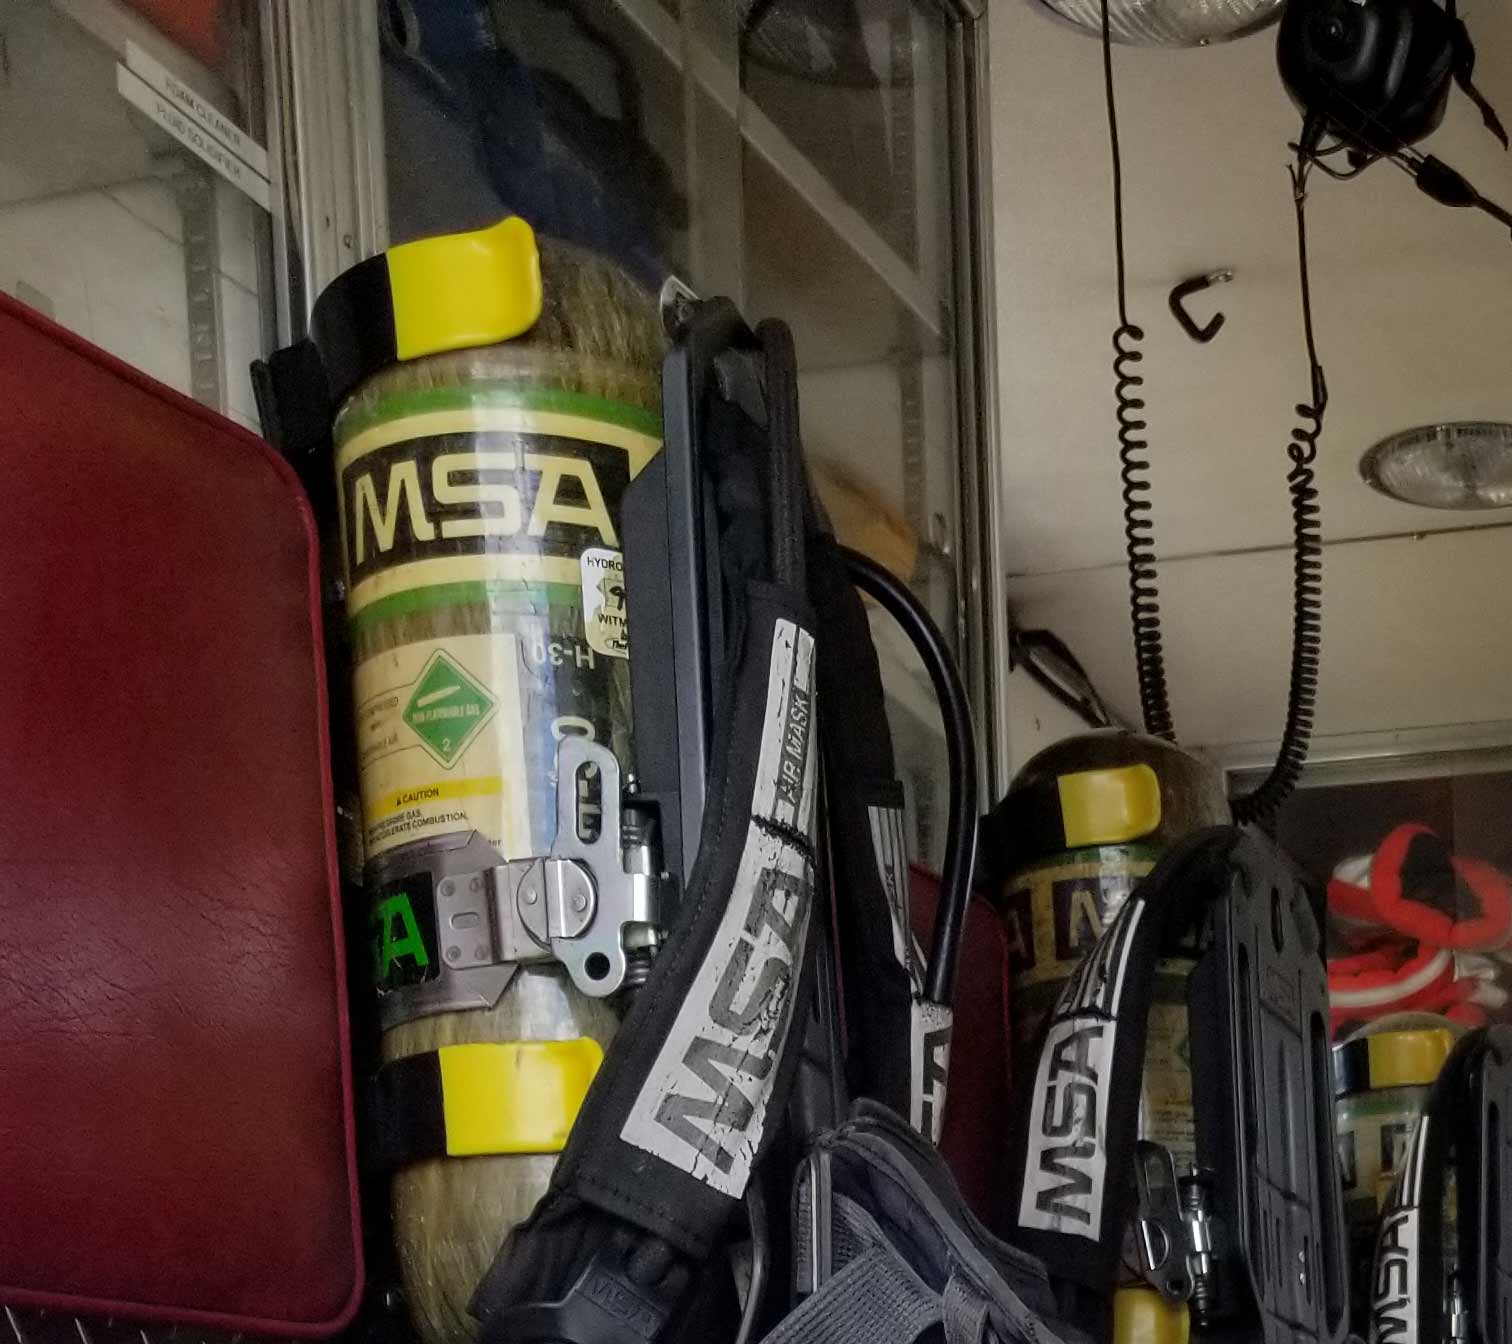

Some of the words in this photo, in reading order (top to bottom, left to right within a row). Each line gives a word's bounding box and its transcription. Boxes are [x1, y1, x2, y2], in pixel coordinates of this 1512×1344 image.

[355, 452, 618, 566] MSA
[402, 787, 440, 804] CAUTION
[442, 737, 451, 752] 2
[654, 866, 814, 1176] MSA
[1035, 1026, 1104, 1226] MSA
